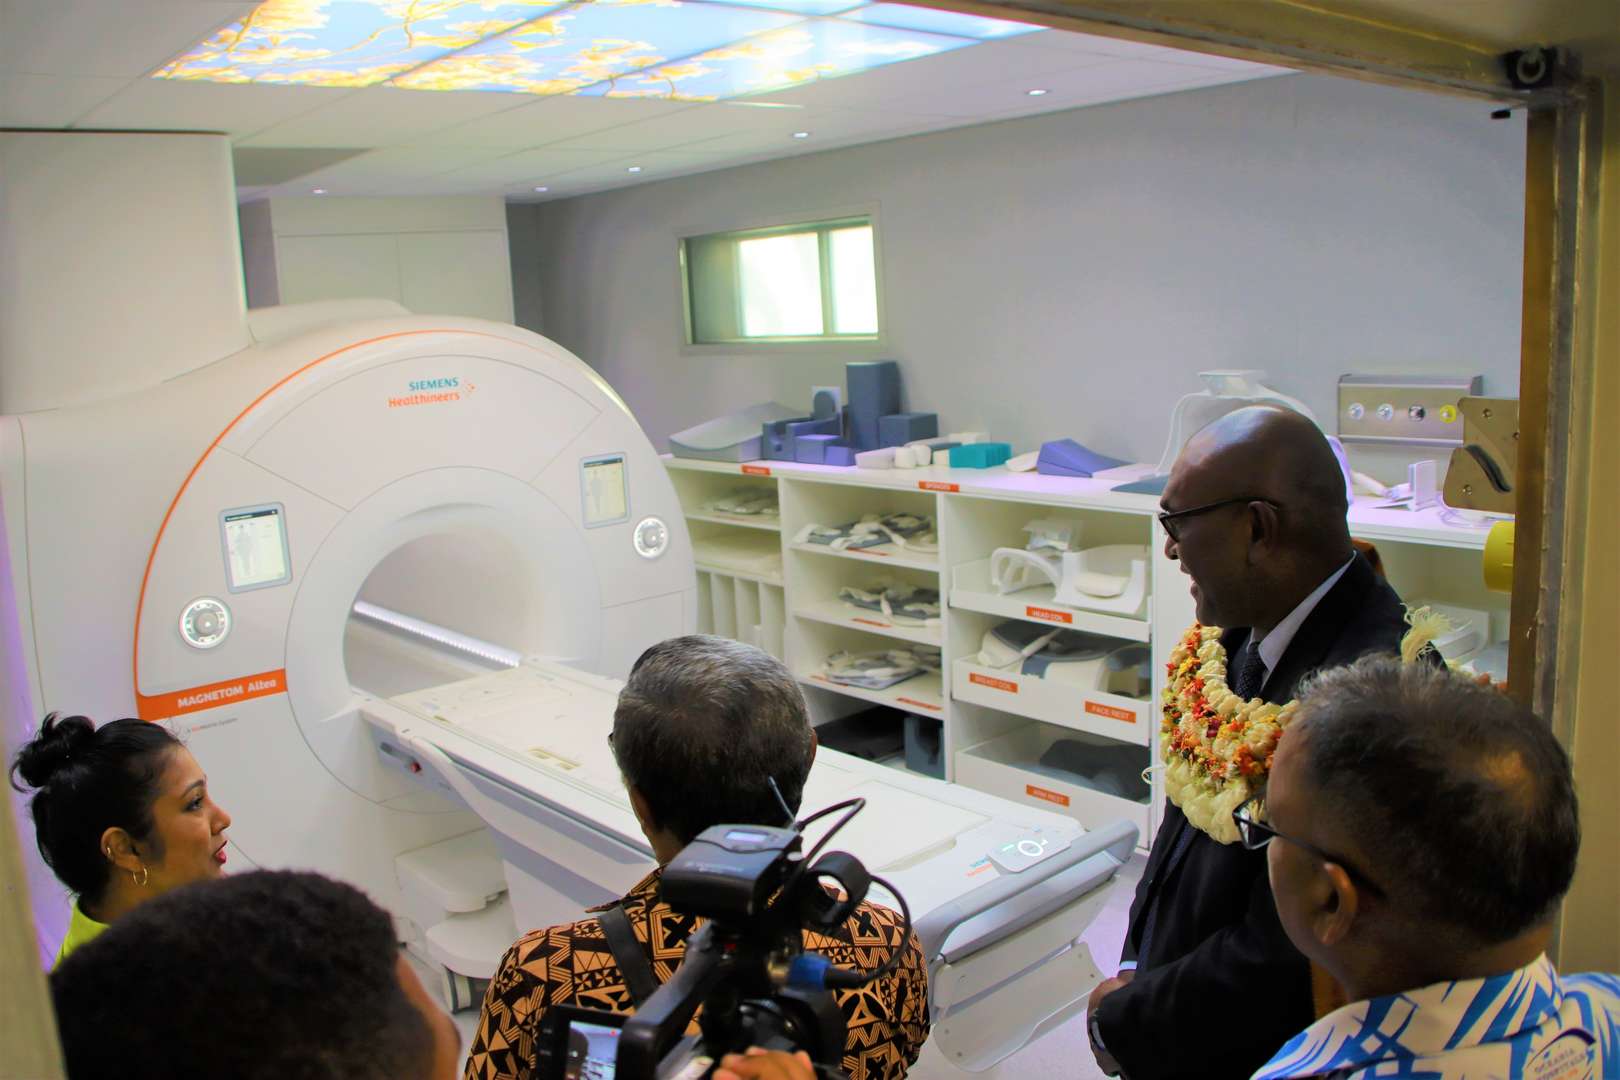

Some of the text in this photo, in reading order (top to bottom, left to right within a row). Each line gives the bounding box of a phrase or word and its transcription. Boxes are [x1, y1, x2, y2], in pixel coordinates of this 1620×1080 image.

[408, 377, 459, 392] SIEMENS
[388, 391, 460, 407] Healthineers
[1033, 610, 1050, 619] HEAD
[177, 678, 277, 708] MAGNETOM Altea
